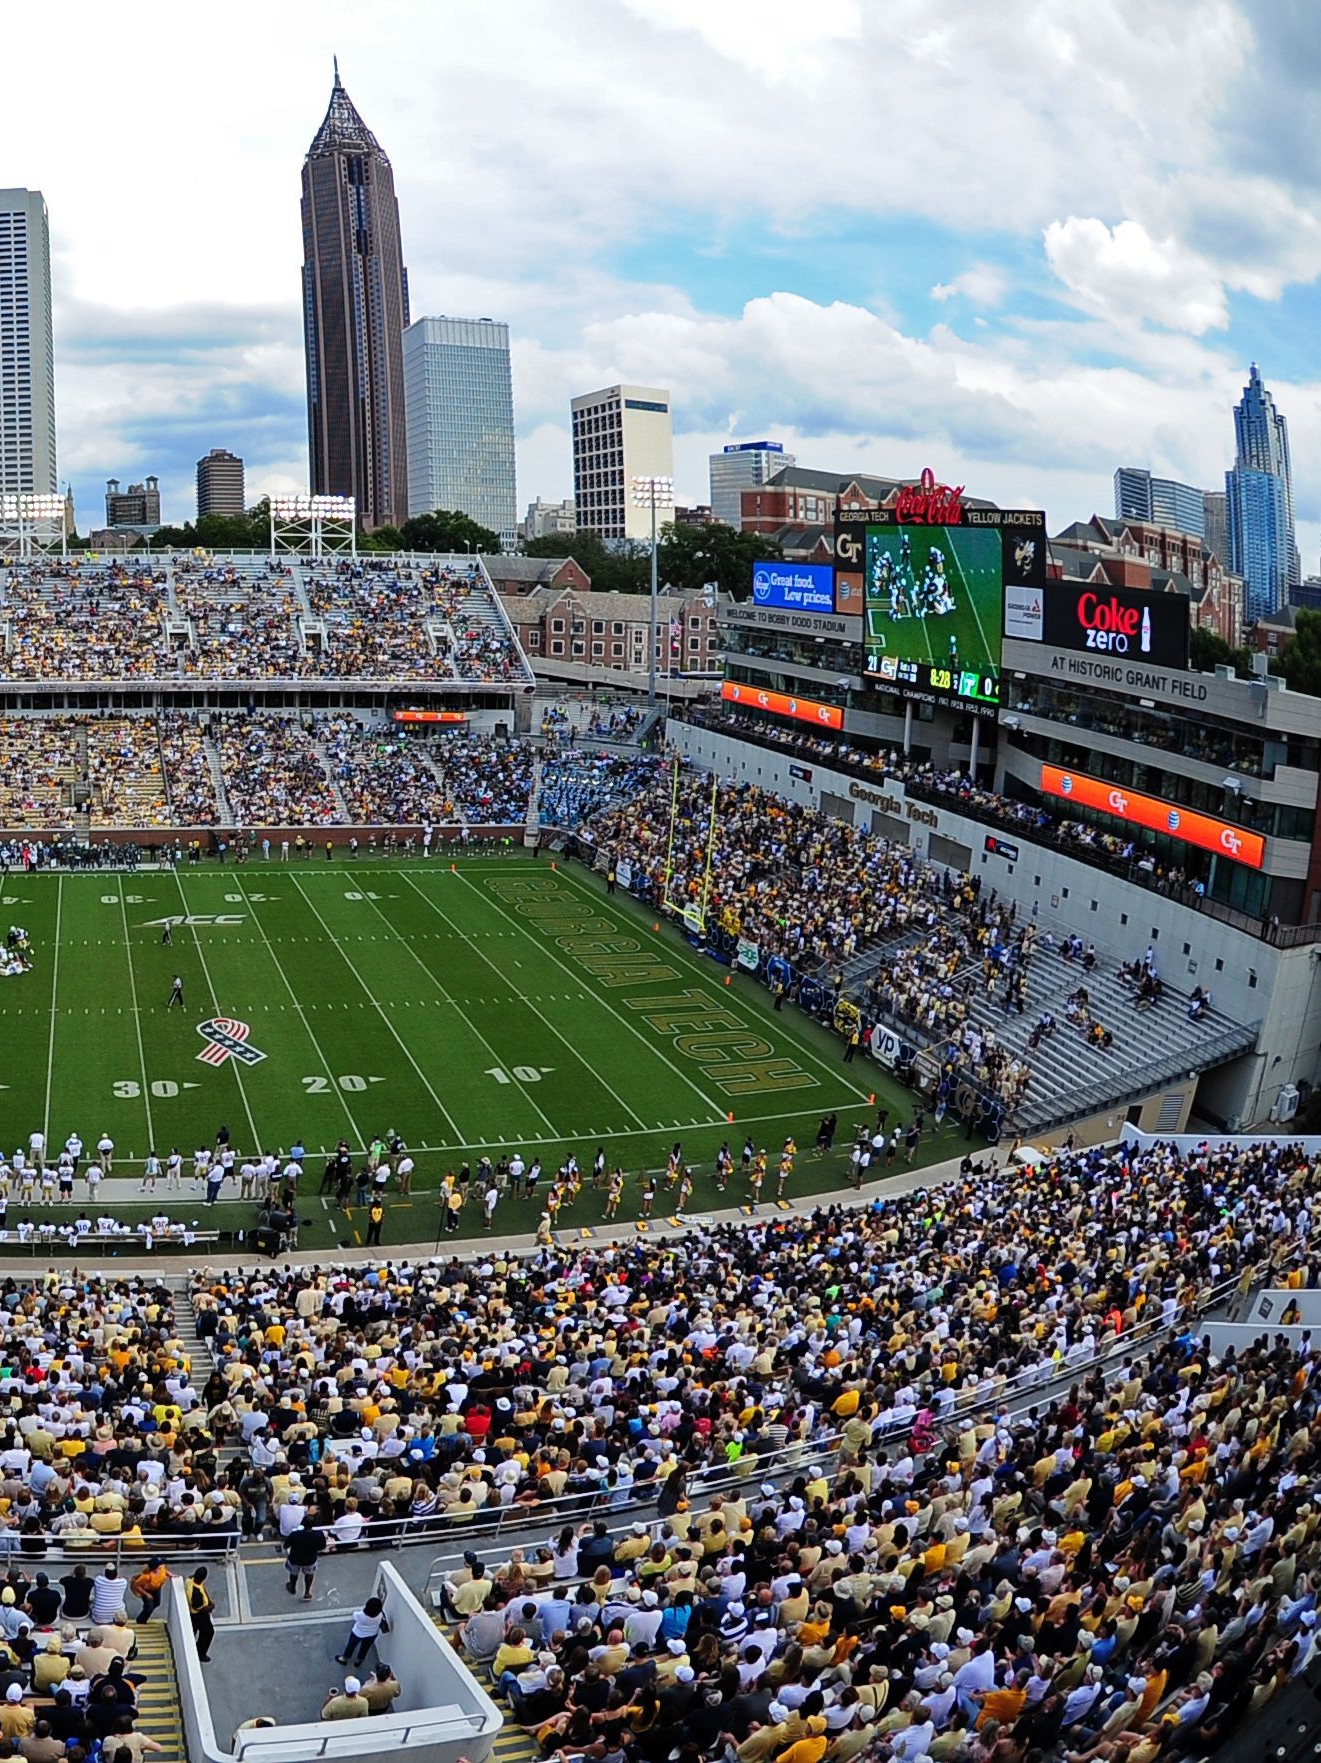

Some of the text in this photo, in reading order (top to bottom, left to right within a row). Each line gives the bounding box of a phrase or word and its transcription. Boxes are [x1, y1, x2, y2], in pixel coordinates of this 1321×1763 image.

[840, 511, 889, 522] GEORGIA TECH
[968, 512, 1043, 526] YELLOW JACKETS
[837, 533, 862, 563] GT
[771, 572, 793, 586] Great
[727, 608, 846, 633] WELCOME TO BOBBY DODD STADIUM
[1078, 592, 1139, 635] Coke
[1086, 629, 1129, 653] zero
[1051, 656, 1207, 701] AT HISTORIC GRANT FIELD
[849, 781, 938, 828] Georgia Tech
[1108, 790, 1128, 813] GT
[1220, 829, 1243, 854] GT
[143, 914, 247, 925] ACC
[484, 877, 822, 1097] GEORGIA TECH
[877, 1030, 895, 1054] yp
[301, 1074, 368, 1095] 20
[484, 1066, 543, 1084] 10
[113, 1079, 180, 1098] 30
